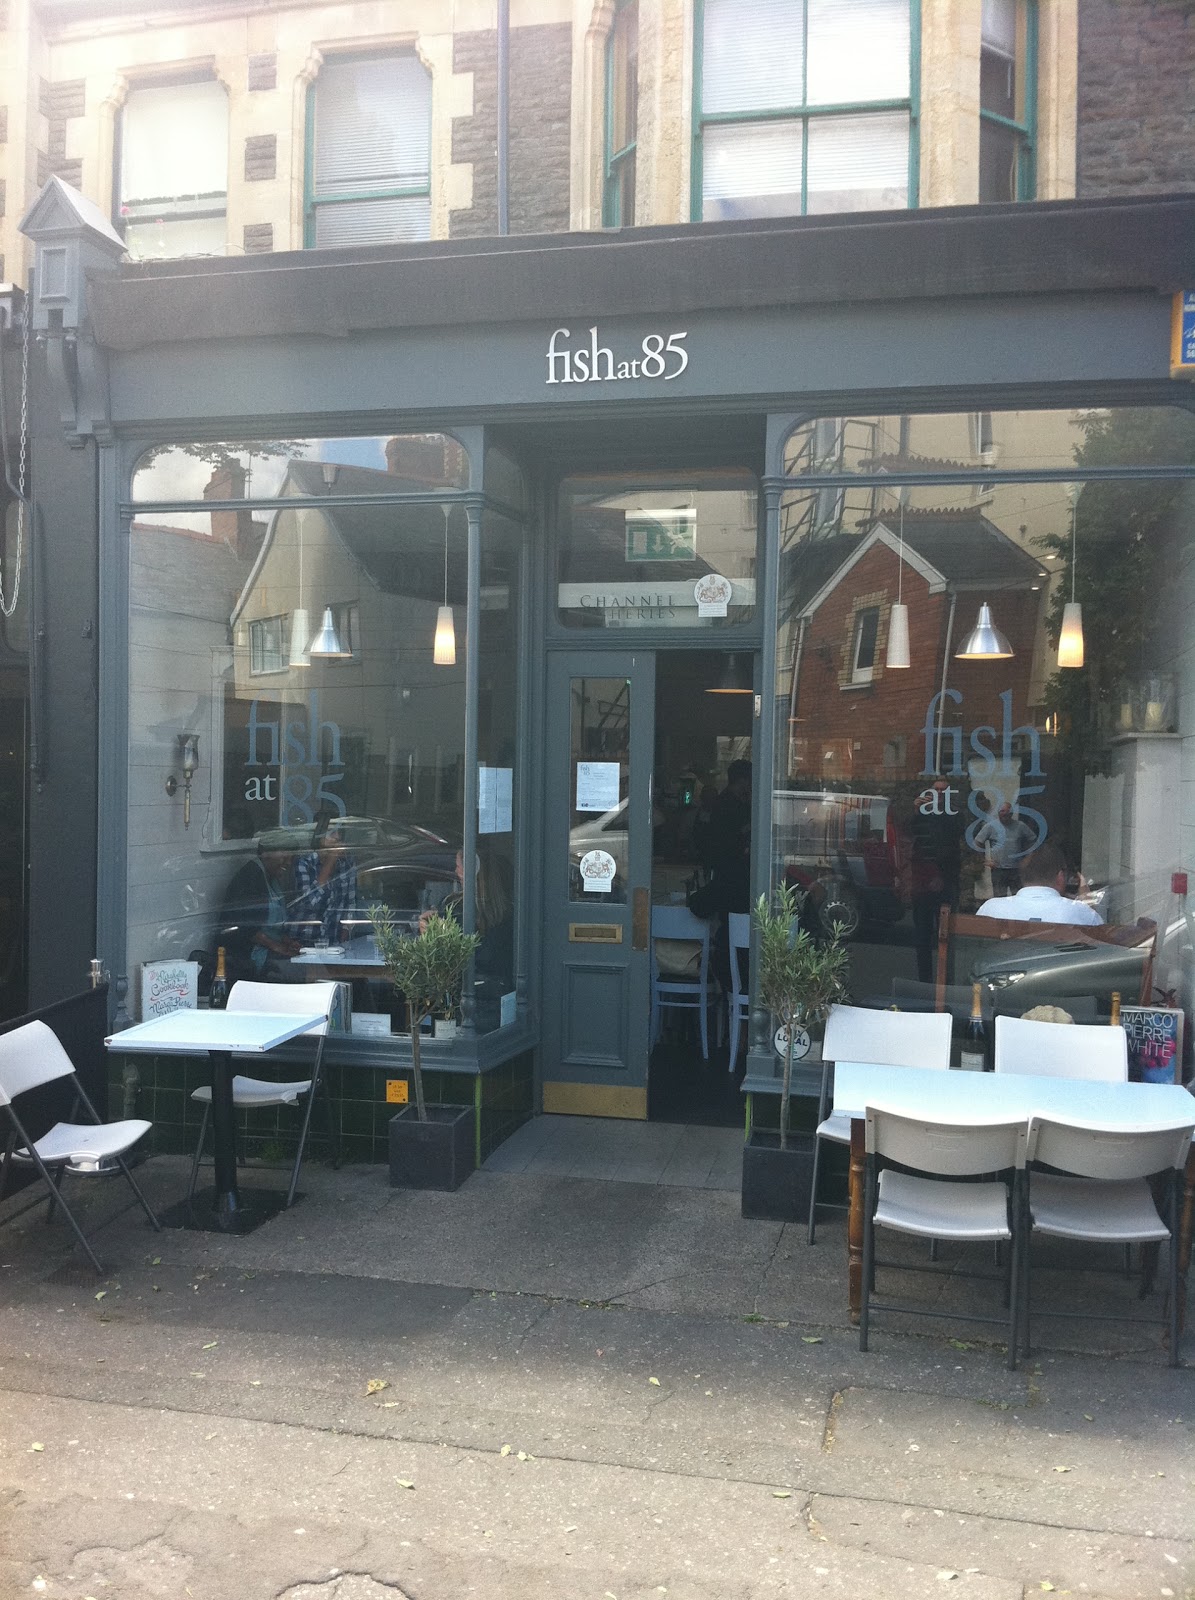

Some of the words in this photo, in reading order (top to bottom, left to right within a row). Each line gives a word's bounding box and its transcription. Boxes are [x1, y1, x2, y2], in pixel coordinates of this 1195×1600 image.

[545, 326, 617, 384] fish
[617, 359, 641, 379] at
[640, 331, 689, 380] 85
[580, 594, 676, 608] CHANNEL
[244, 688, 346, 766] fish
[918, 688, 1048, 778] fish
[244, 774, 277, 801] at
[280, 772, 348, 838] 85
[919, 785, 959, 816] at
[964, 784, 1049, 859] 85
[777, 1033, 808, 1047] LOAL
[1123, 1012, 1174, 1029] MARCO
[1123, 1023, 1172, 1044] PIERRE
[1127, 1039, 1172, 1059] WHITE
